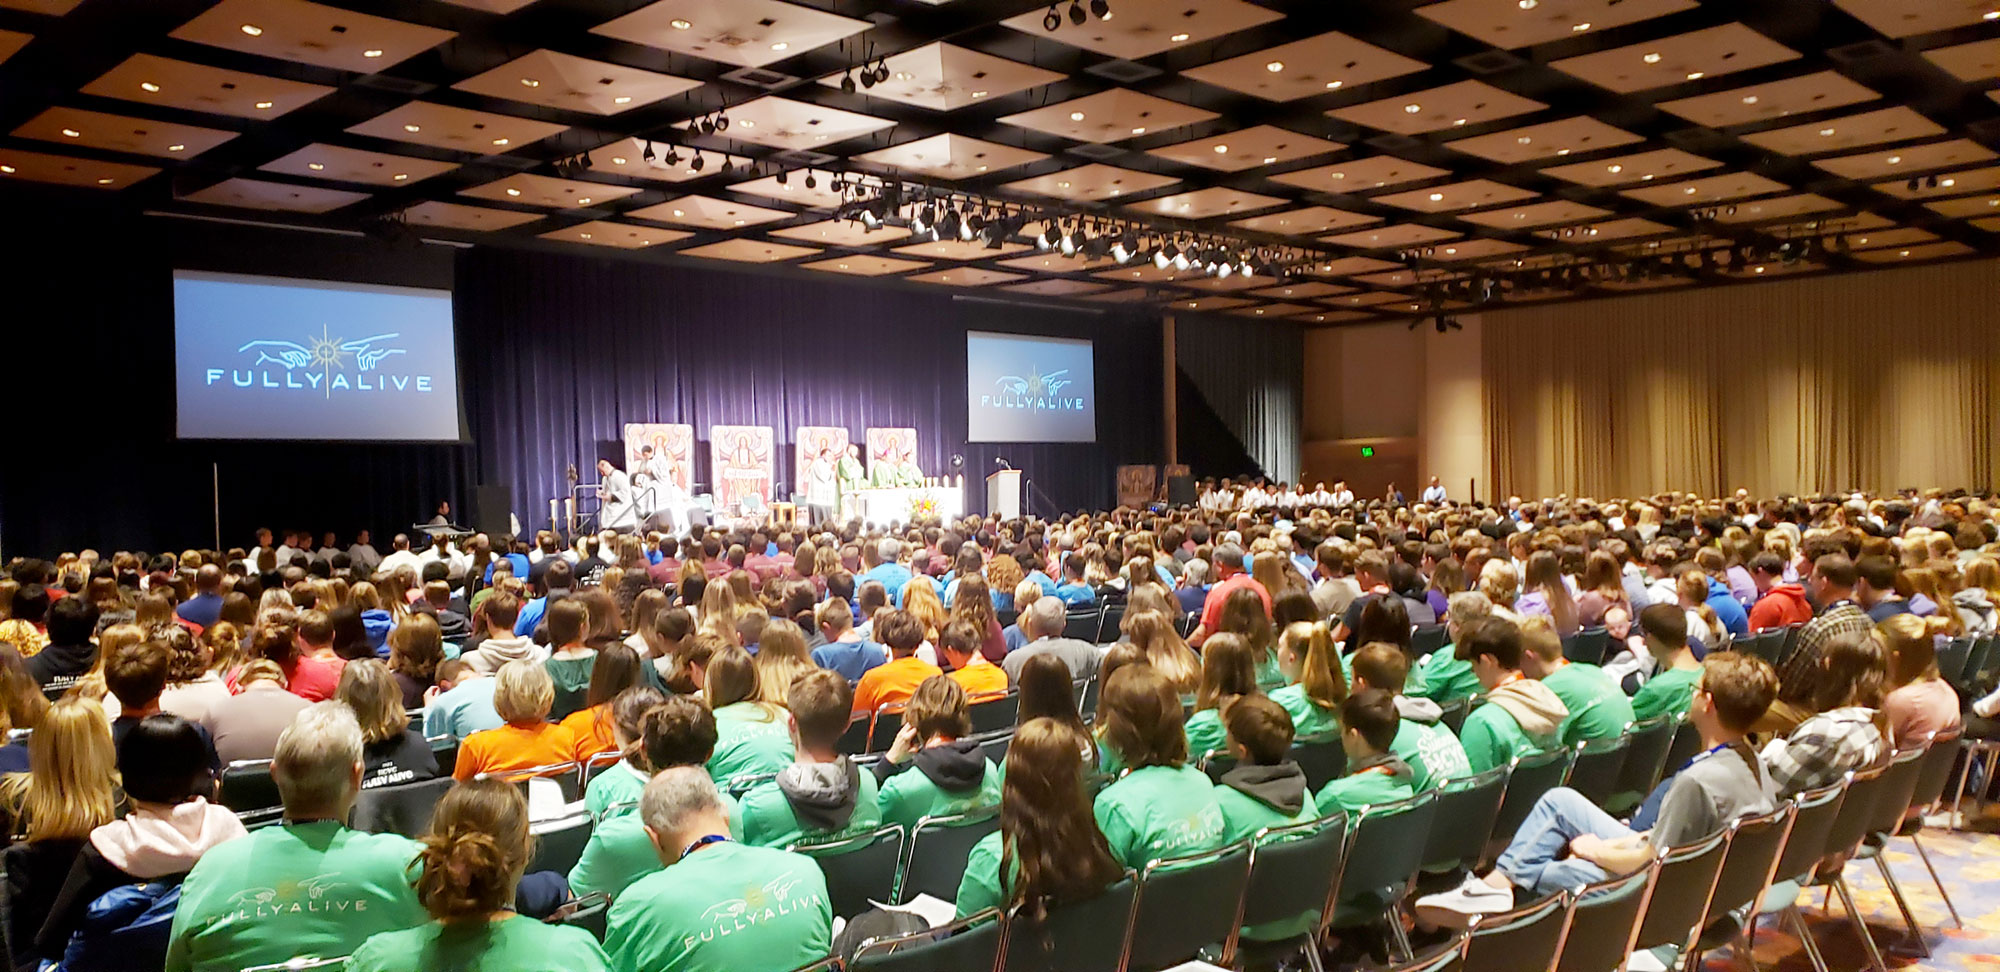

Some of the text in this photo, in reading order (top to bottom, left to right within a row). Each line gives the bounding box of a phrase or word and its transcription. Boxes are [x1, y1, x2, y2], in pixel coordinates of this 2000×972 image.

[207, 369, 432, 391] FULLY ALIVE
[981, 395, 1084, 410] FULLY ALIVE
[206, 899, 368, 926] FULLY ALIVE
[684, 911, 758, 951] FULLY
